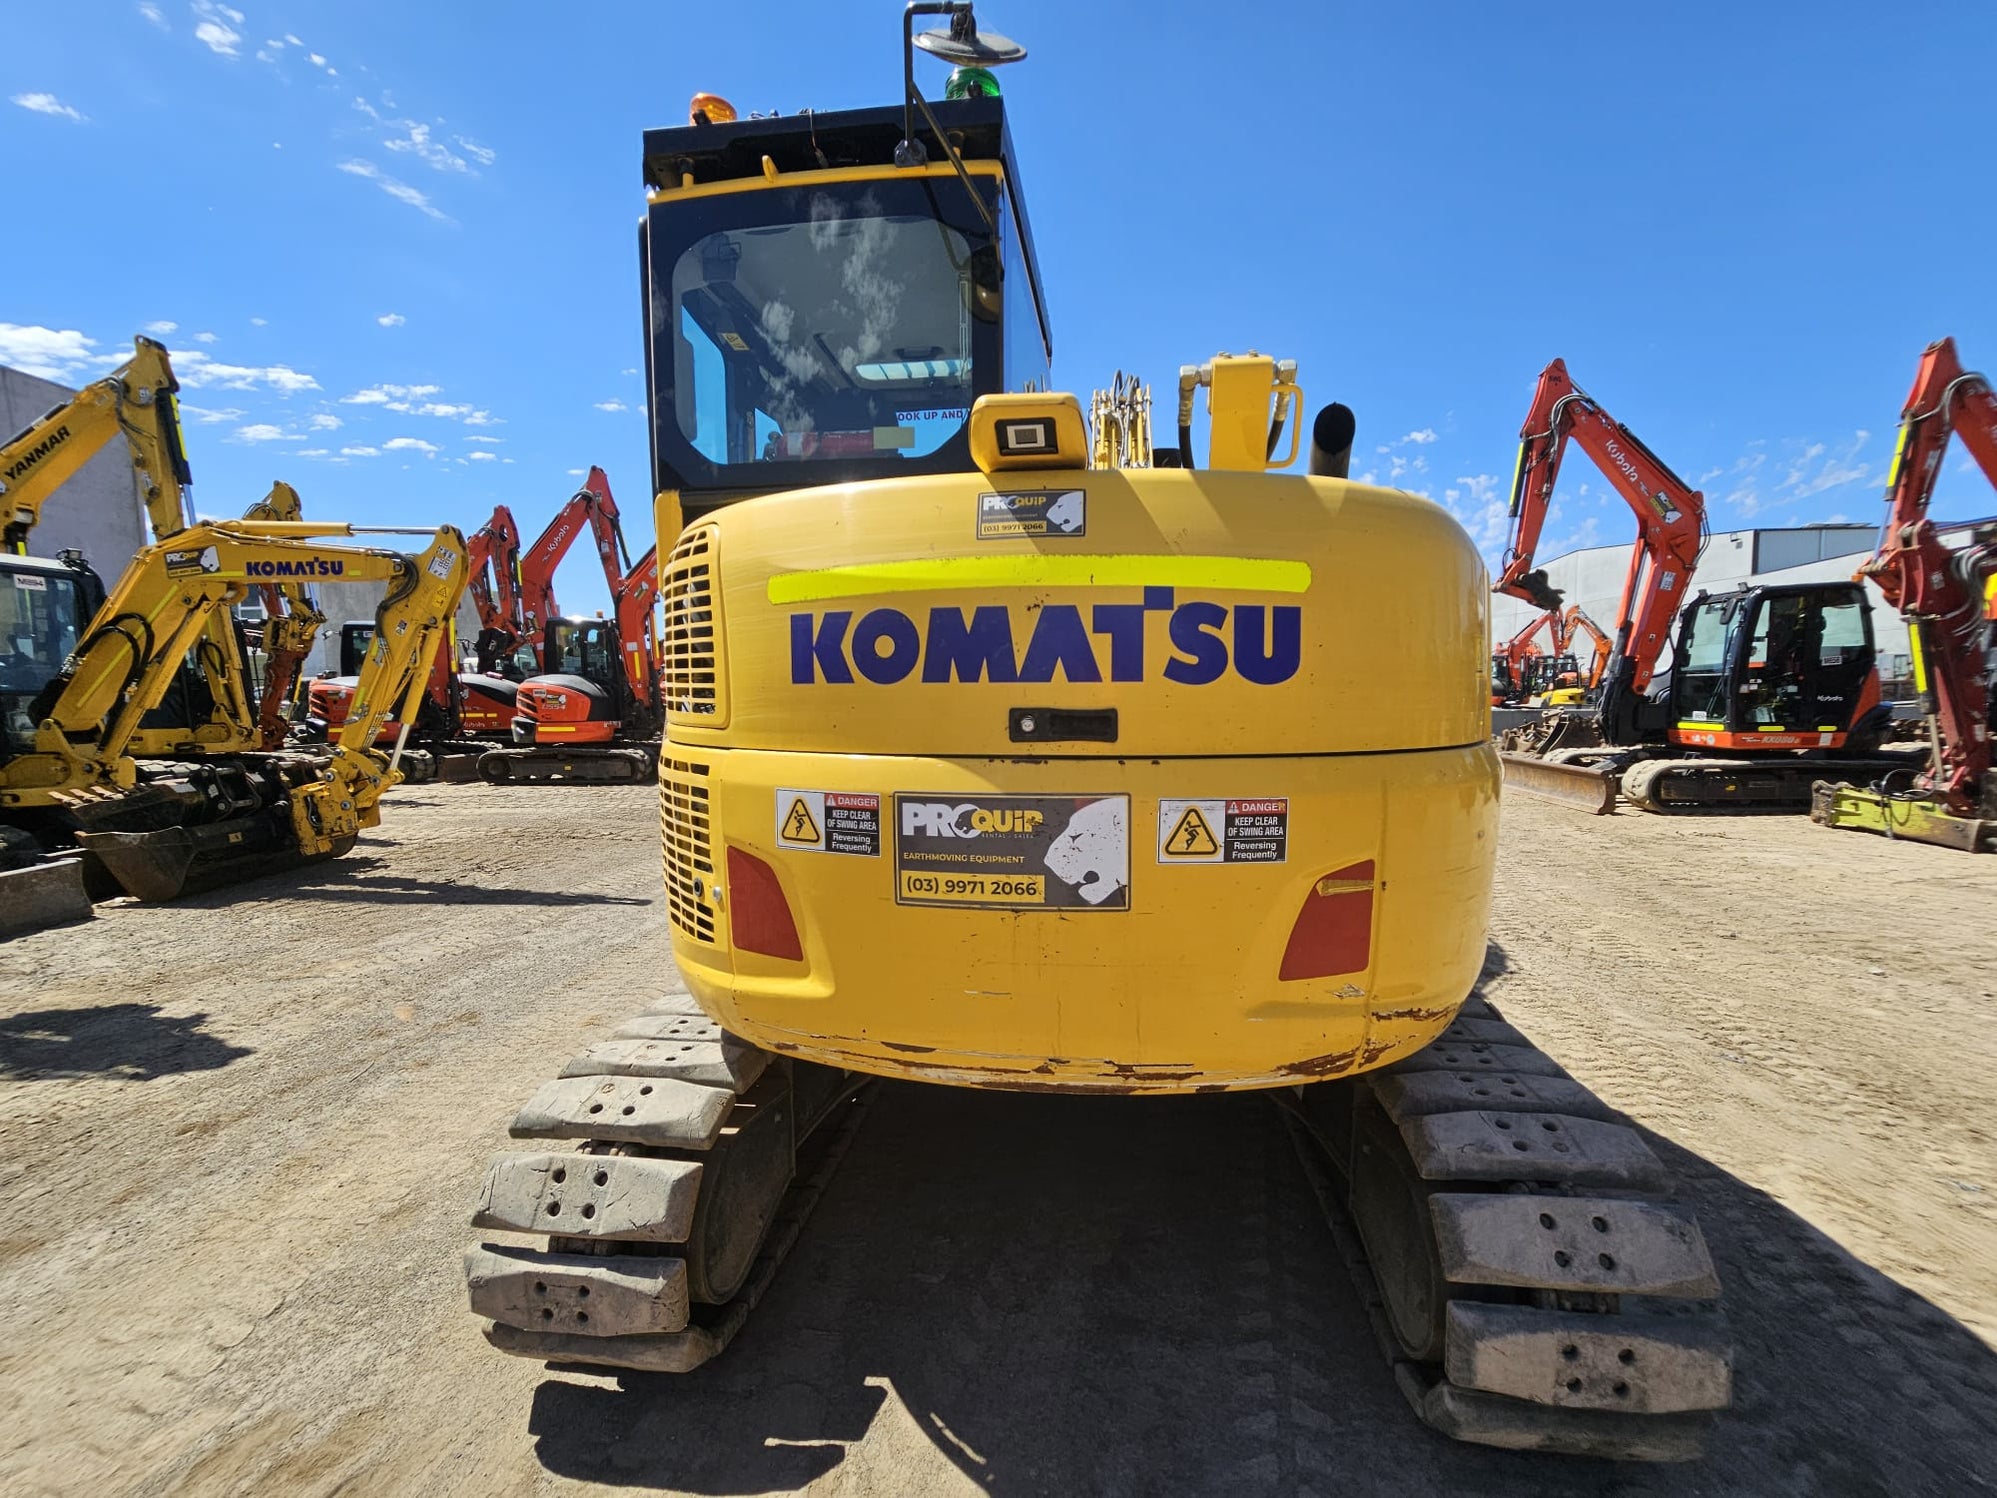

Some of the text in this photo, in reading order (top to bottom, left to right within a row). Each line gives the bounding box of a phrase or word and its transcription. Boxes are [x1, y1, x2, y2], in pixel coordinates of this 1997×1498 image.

[897, 410, 964, 421] OOK UP AND
[4, 425, 71, 480] YANMAR
[1605, 439, 1638, 482] Kubota
[547, 524, 569, 552] Kubota
[246, 556, 343, 576] KOMATSU
[790, 586, 1302, 685] KOMATSU
[837, 797, 878, 807] DANGER
[1241, 801, 1286, 812] DANGER
[832, 809, 871, 820] KEEP CLEAR
[902, 803, 1043, 838] PROQUIP
[1235, 816, 1278, 826] KEEP CLEAR
[827, 818, 877, 831] OF SWING AREA
[1228, 826, 1284, 837] OF SWING AREA
[833, 832, 871, 845] Reversing
[832, 841, 872, 854] Frequently
[1234, 841, 1277, 851] Reversing
[903, 852, 1025, 864] EARTHMOVING EQUIPMENT
[1232, 851, 1278, 861] Frequently
[906, 876, 1037, 896] (03) 9971 2066
